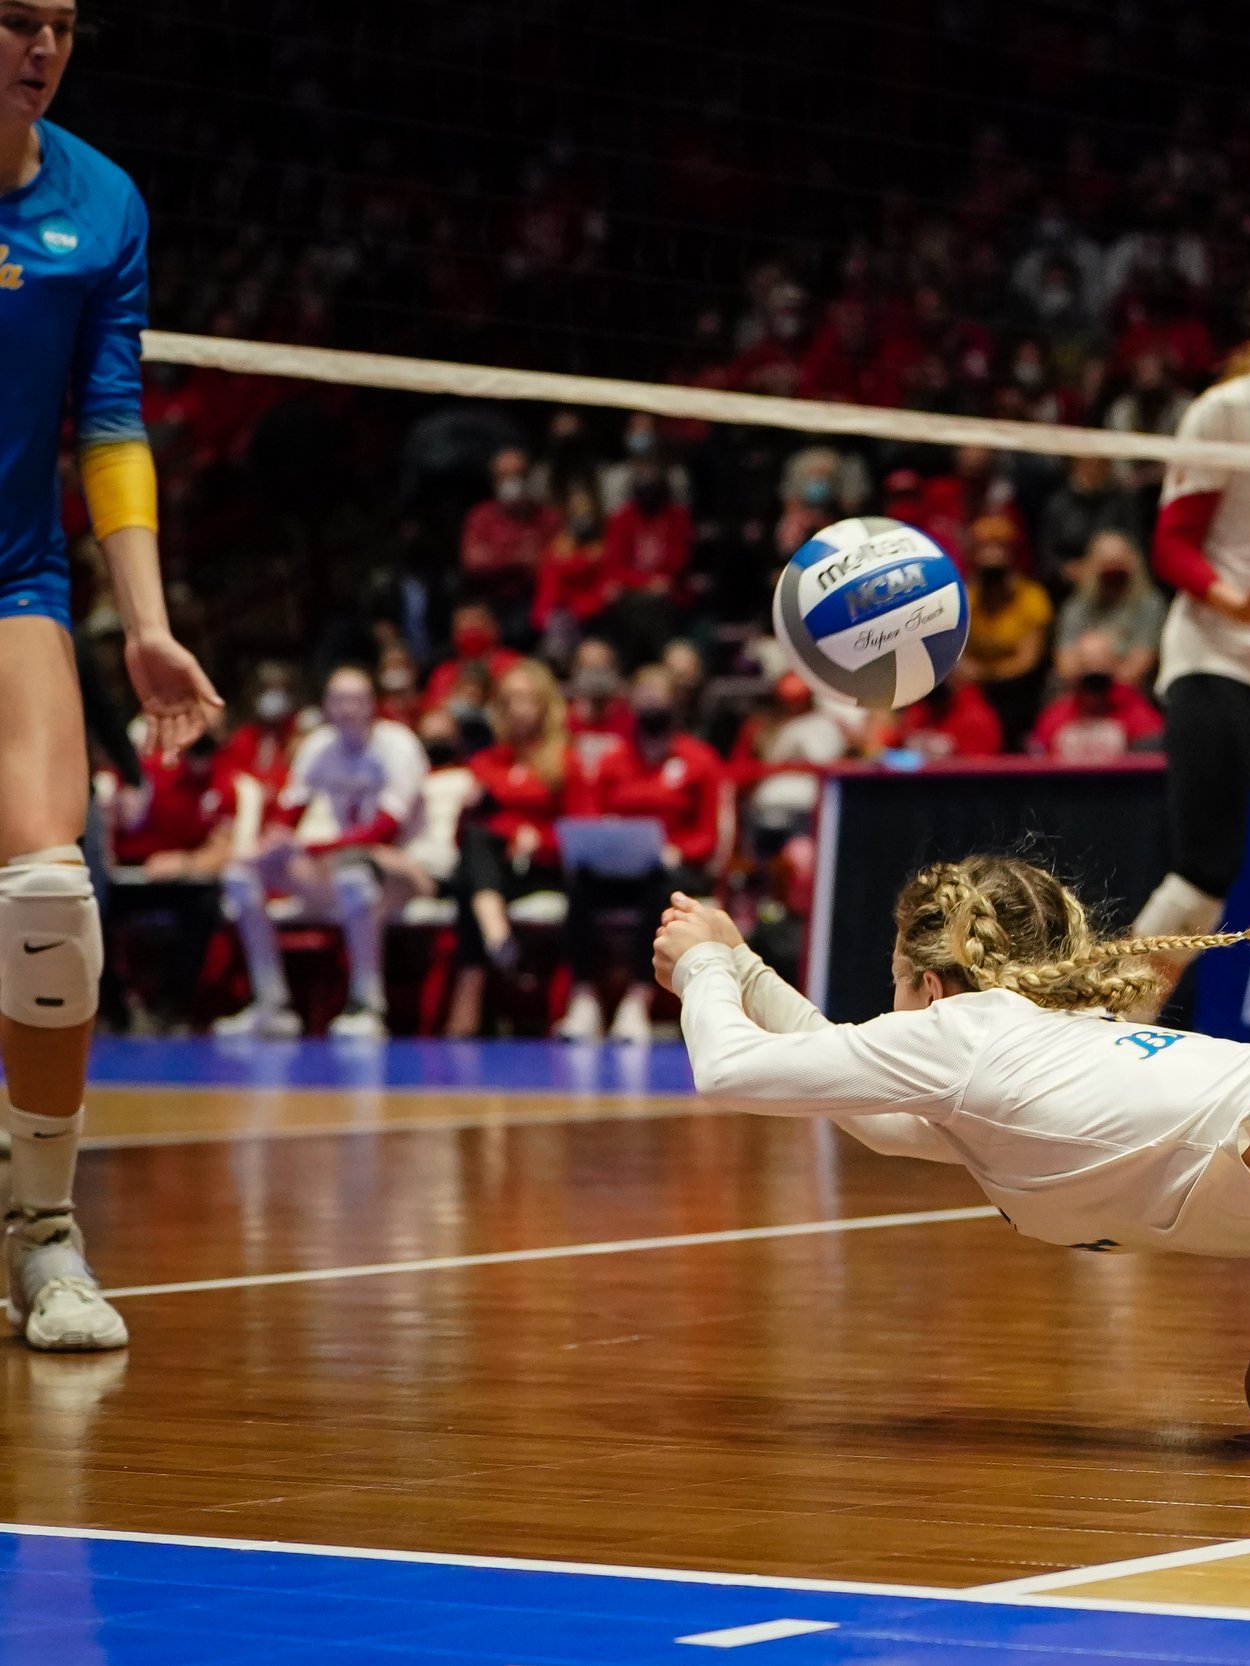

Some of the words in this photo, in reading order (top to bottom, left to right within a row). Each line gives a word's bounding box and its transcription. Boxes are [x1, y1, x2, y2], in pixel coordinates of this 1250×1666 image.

[817, 537, 916, 592] molten
[844, 562, 928, 623] NCAA
[853, 626, 901, 651] Super
